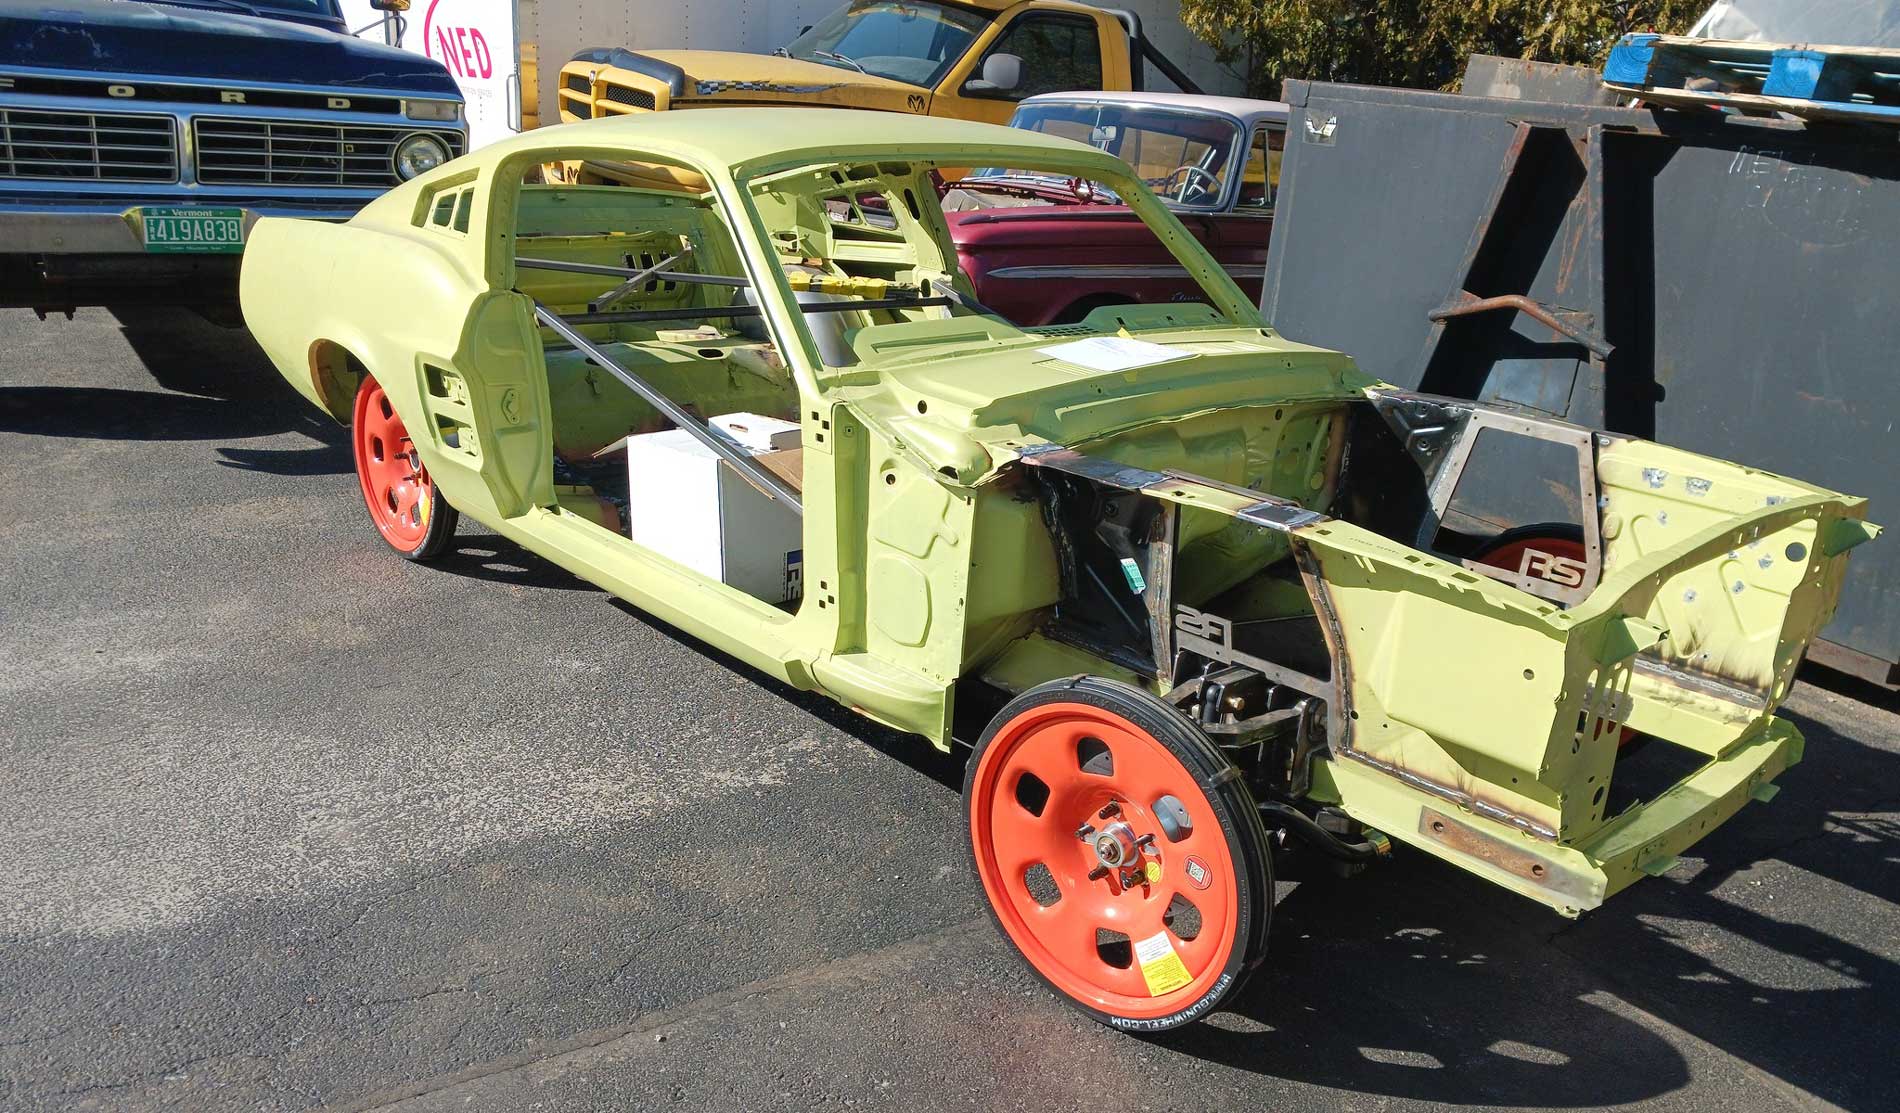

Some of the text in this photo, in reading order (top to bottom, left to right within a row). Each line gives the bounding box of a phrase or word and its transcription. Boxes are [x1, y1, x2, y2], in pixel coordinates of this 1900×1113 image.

[437, 26, 493, 79] NED
[157, 219, 239, 241] 419A838
[172, 209, 213, 217] Vermont
[1519, 547, 1582, 587] RS
[1111, 973, 1232, 1030] WWW.GUNIWHEEL.COM
